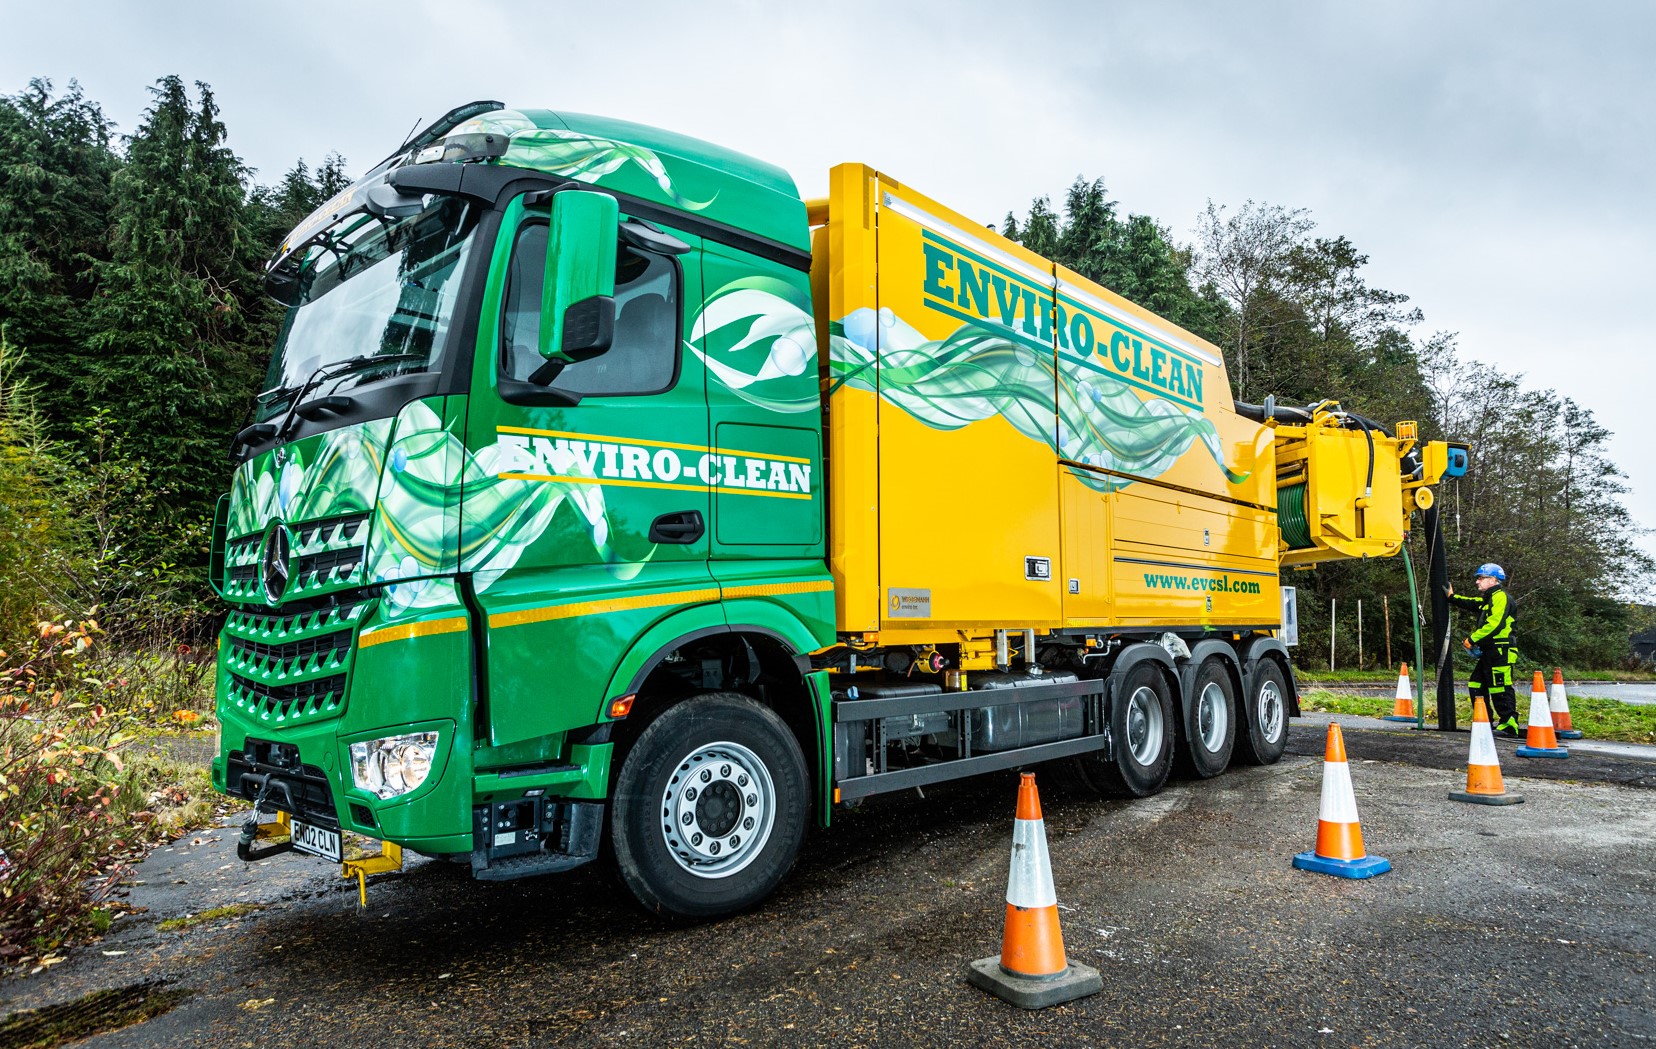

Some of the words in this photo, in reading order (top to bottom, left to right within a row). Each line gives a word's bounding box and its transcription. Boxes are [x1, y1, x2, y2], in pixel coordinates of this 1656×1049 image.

[923, 242, 1204, 403] ENVIRO-CLEAN
[497, 434, 811, 493] ENVIRO-CLEAN
[1144, 573, 1261, 594] www.evcsl.com
[294, 822, 317, 848] EN02
[318, 830, 336, 854] CLN
